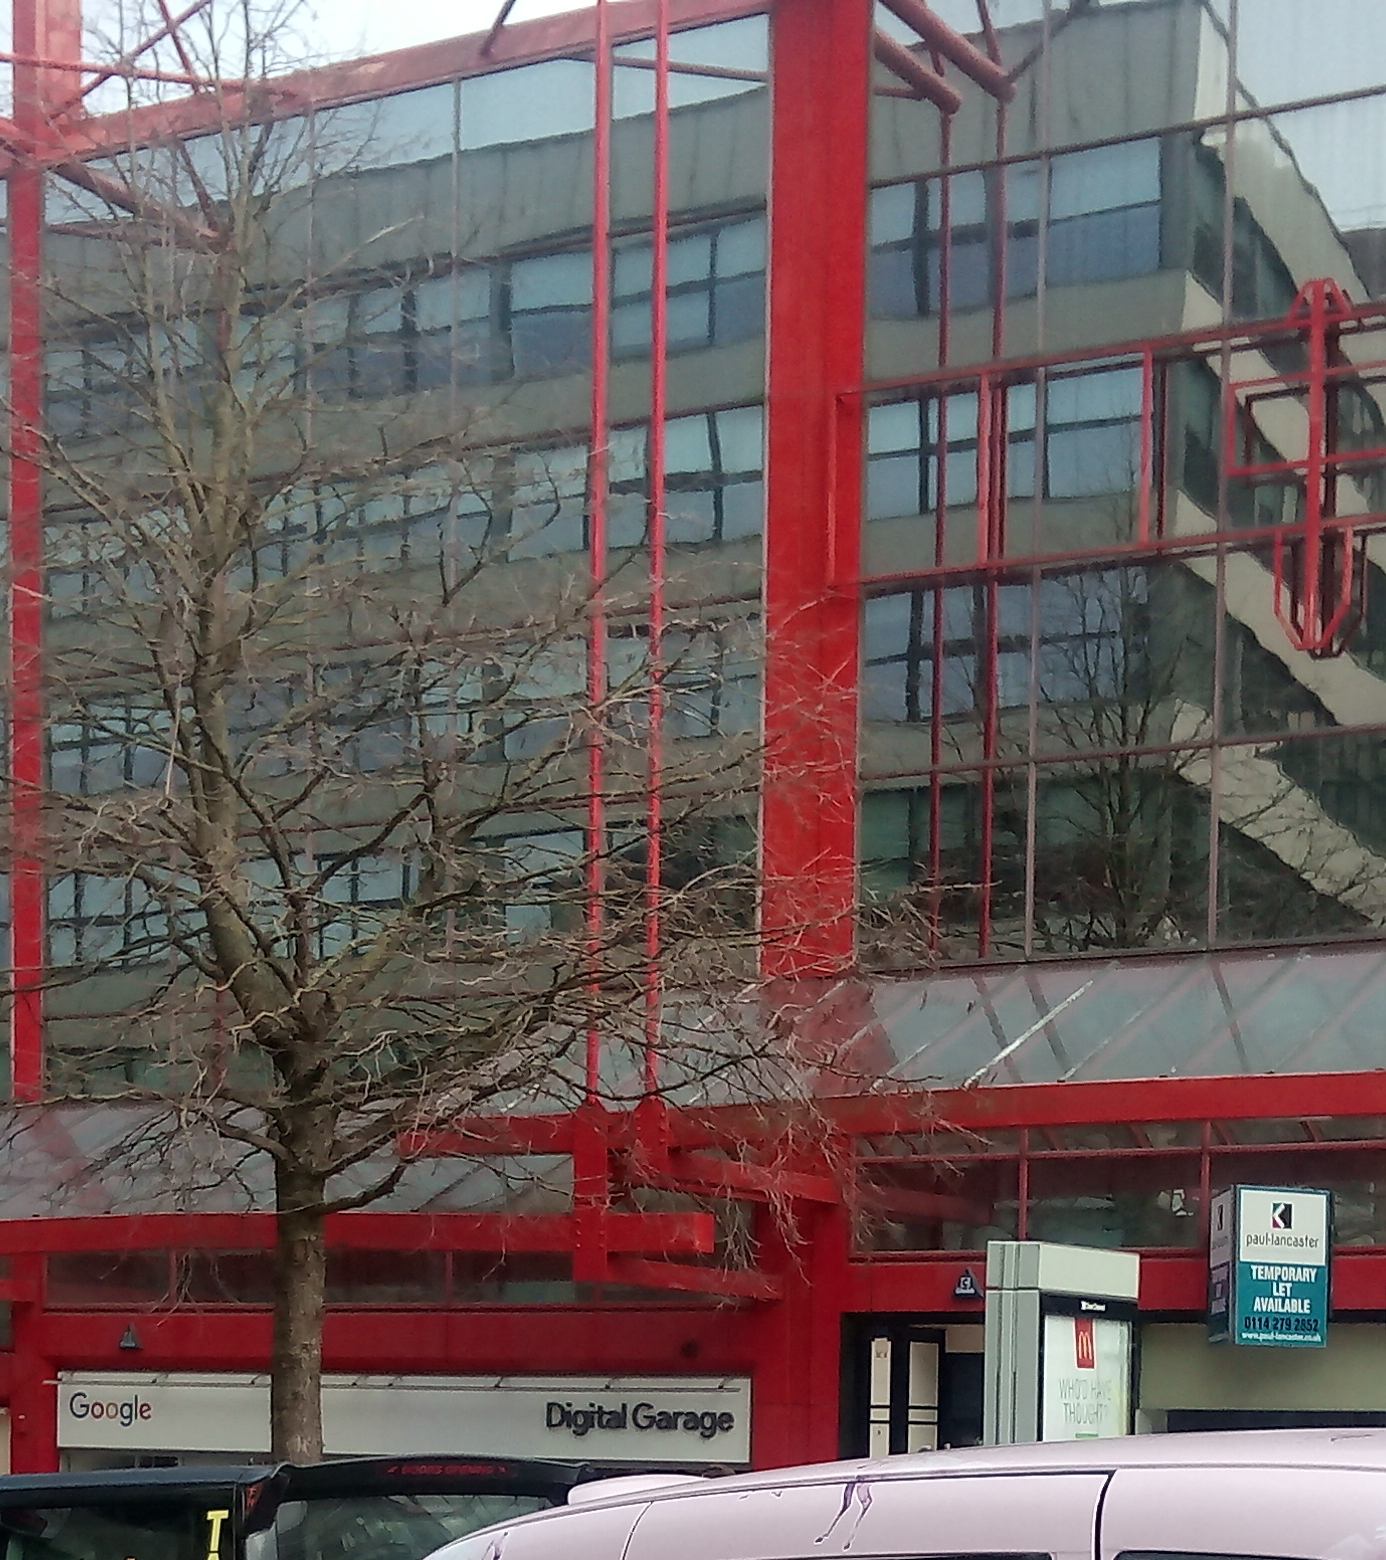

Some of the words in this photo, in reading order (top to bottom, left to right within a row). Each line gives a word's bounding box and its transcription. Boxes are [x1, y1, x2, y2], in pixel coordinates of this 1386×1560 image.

[1251, 1265, 1317, 1283] TEMPORARY
[1272, 1282, 1292, 1297] LET
[1253, 1297, 1311, 1314] AVAILABLE
[1244, 1316, 1269, 1329] 0114
[1272, 1317, 1292, 1331] 279
[69, 1391, 152, 1428] Google
[546, 1402, 628, 1437] Digital
[632, 1402, 735, 1438] Garage
